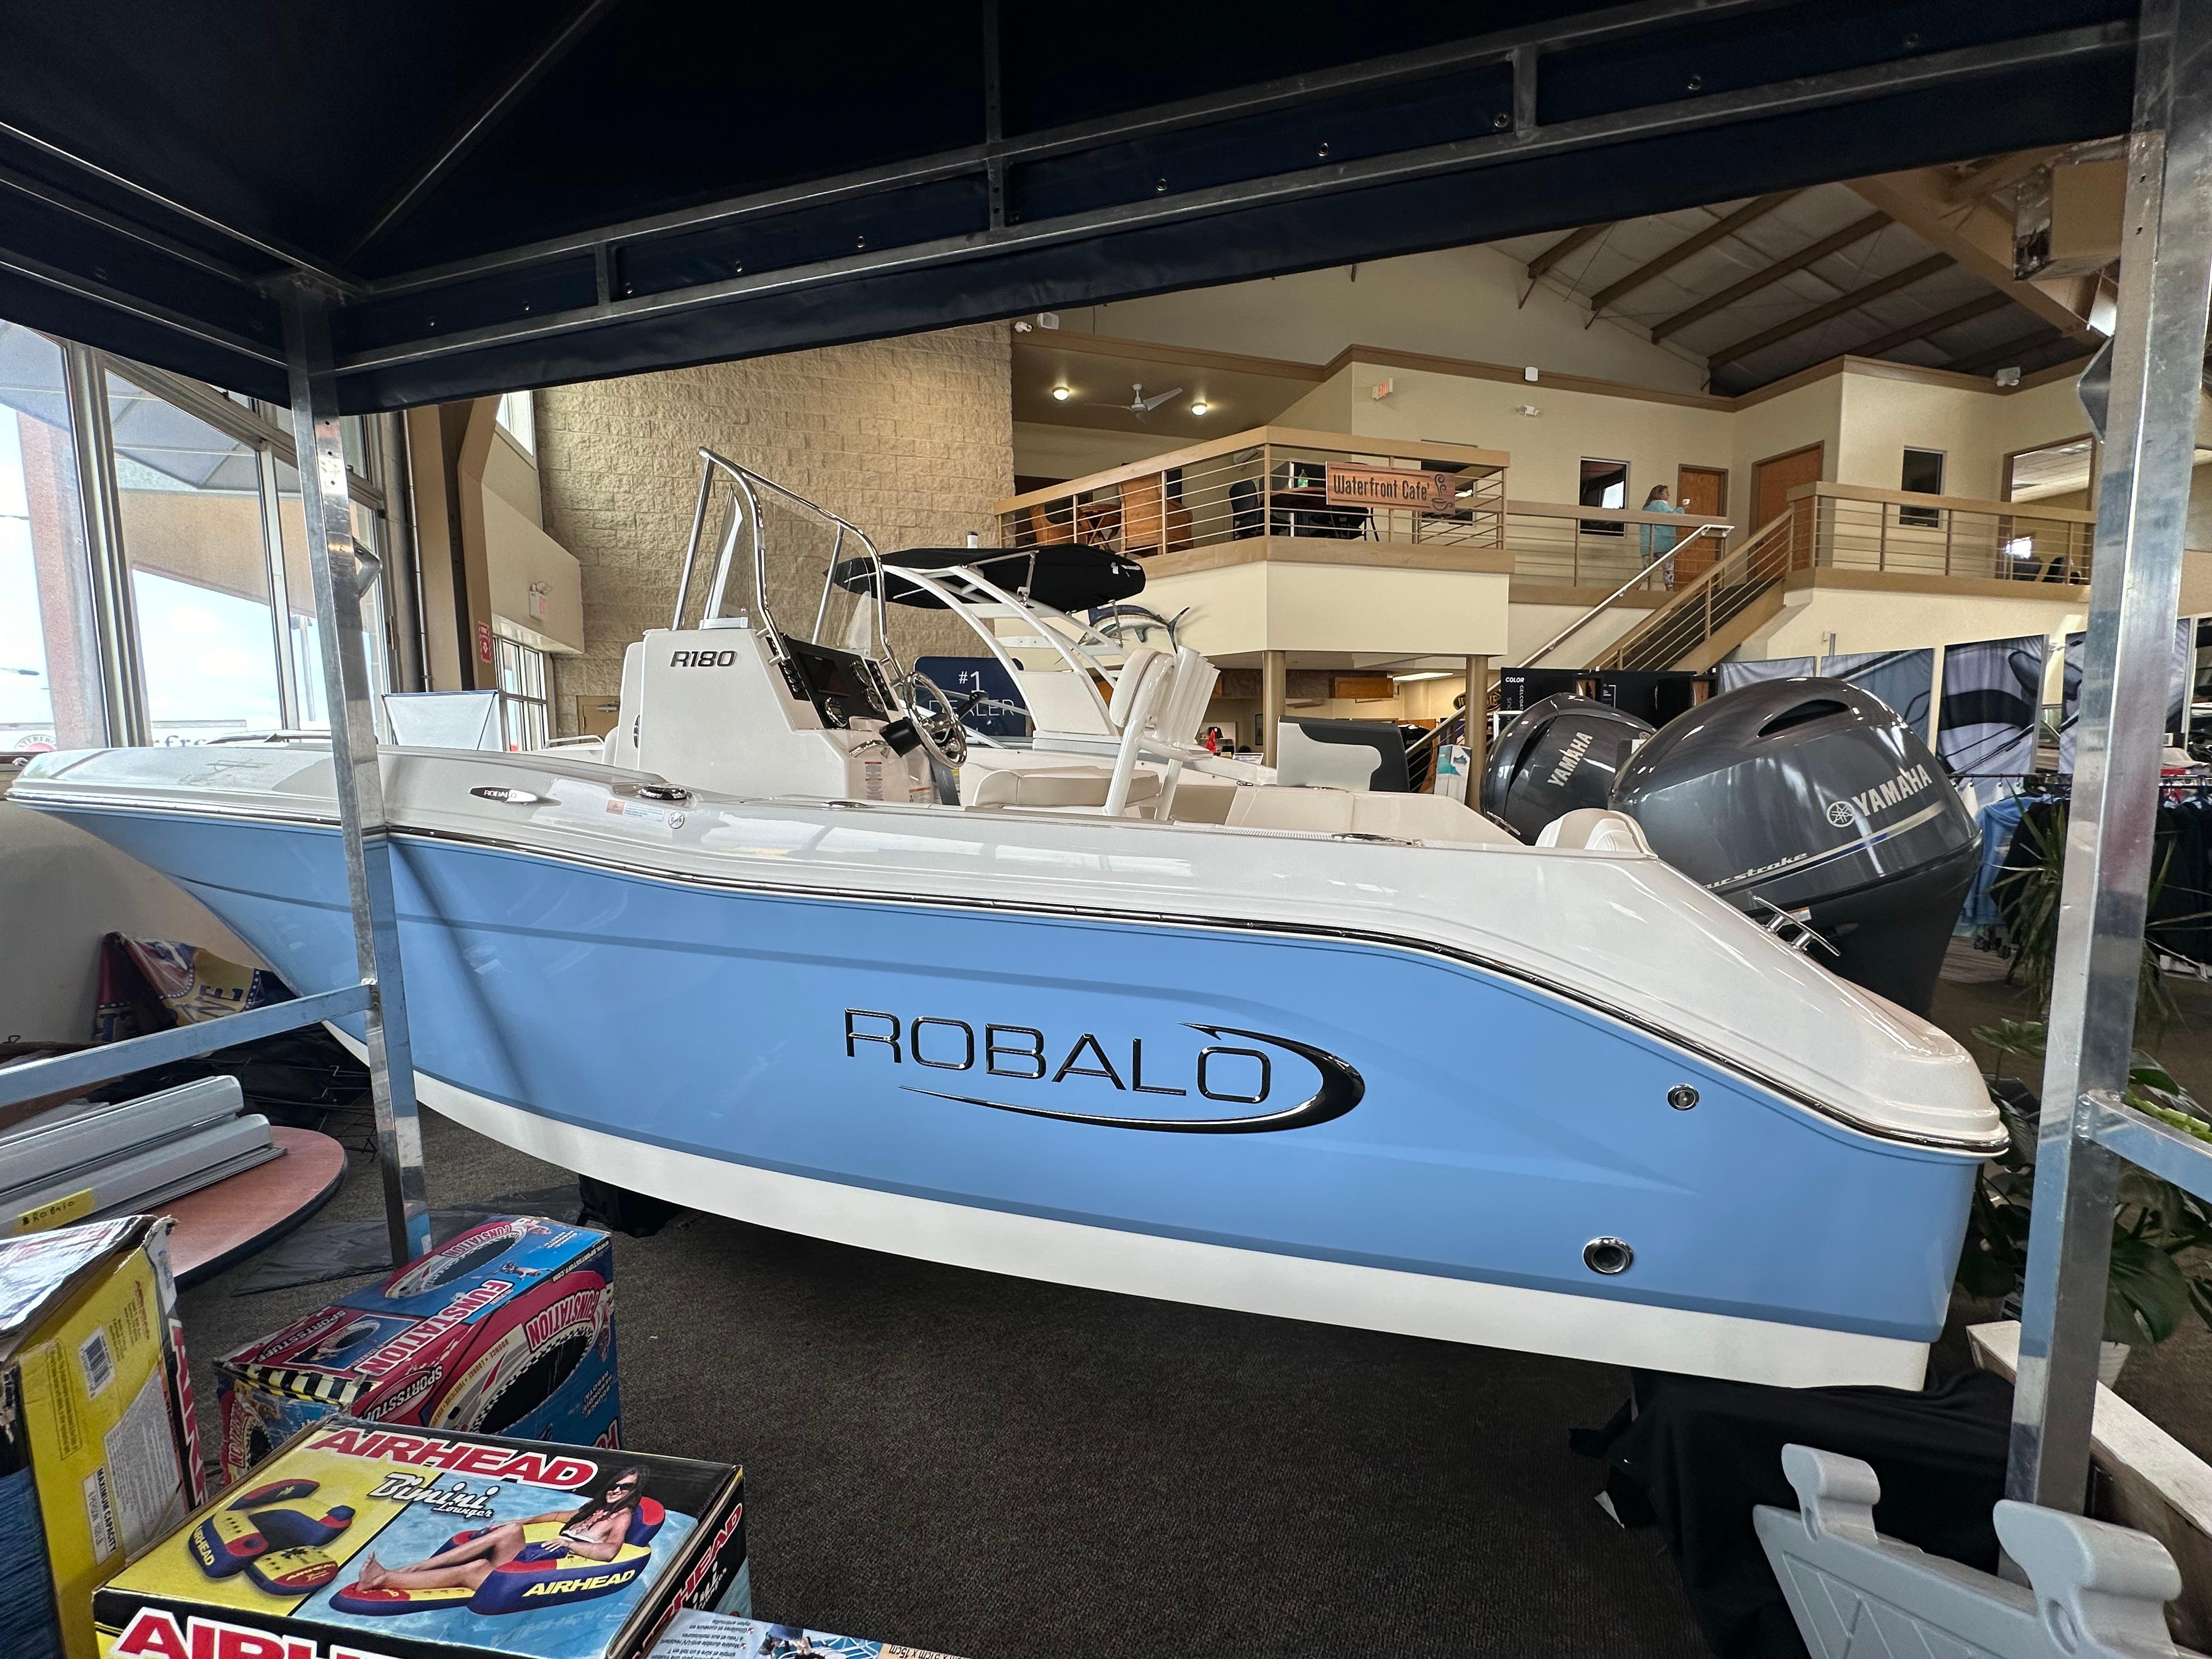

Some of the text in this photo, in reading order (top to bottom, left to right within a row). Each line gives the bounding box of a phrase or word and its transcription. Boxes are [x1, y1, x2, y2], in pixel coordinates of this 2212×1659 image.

[1333, 473, 1397, 499] Waterfront
[670, 650, 737, 667] R180
[958, 671, 985, 692] #1
[929, 699, 1014, 716] DELER
[1547, 732, 1593, 787] YAMAHA
[1852, 764, 1933, 817] YAMAHA
[844, 1007, 1271, 1104] ROBALO
[441, 1224, 513, 1259] FUNSTATION
[256, 1310, 347, 1363] SPORTSSTUFF
[354, 1279, 514, 1376] FUNSTATION
[526, 1289, 601, 1351] FUNSTATION
[362, 1364, 443, 1421] SPORTSSTU
[305, 1427, 599, 1491] AIRHEAD
[96, 1467, 118, 1552] MAXIMUM CAPACITY
[367, 1471, 500, 1510] Bimini
[432, 1502, 494, 1519] Lounger
[523, 1568, 636, 1598] AIRHEAD
[889, 1645, 910, 1658] 15cm
